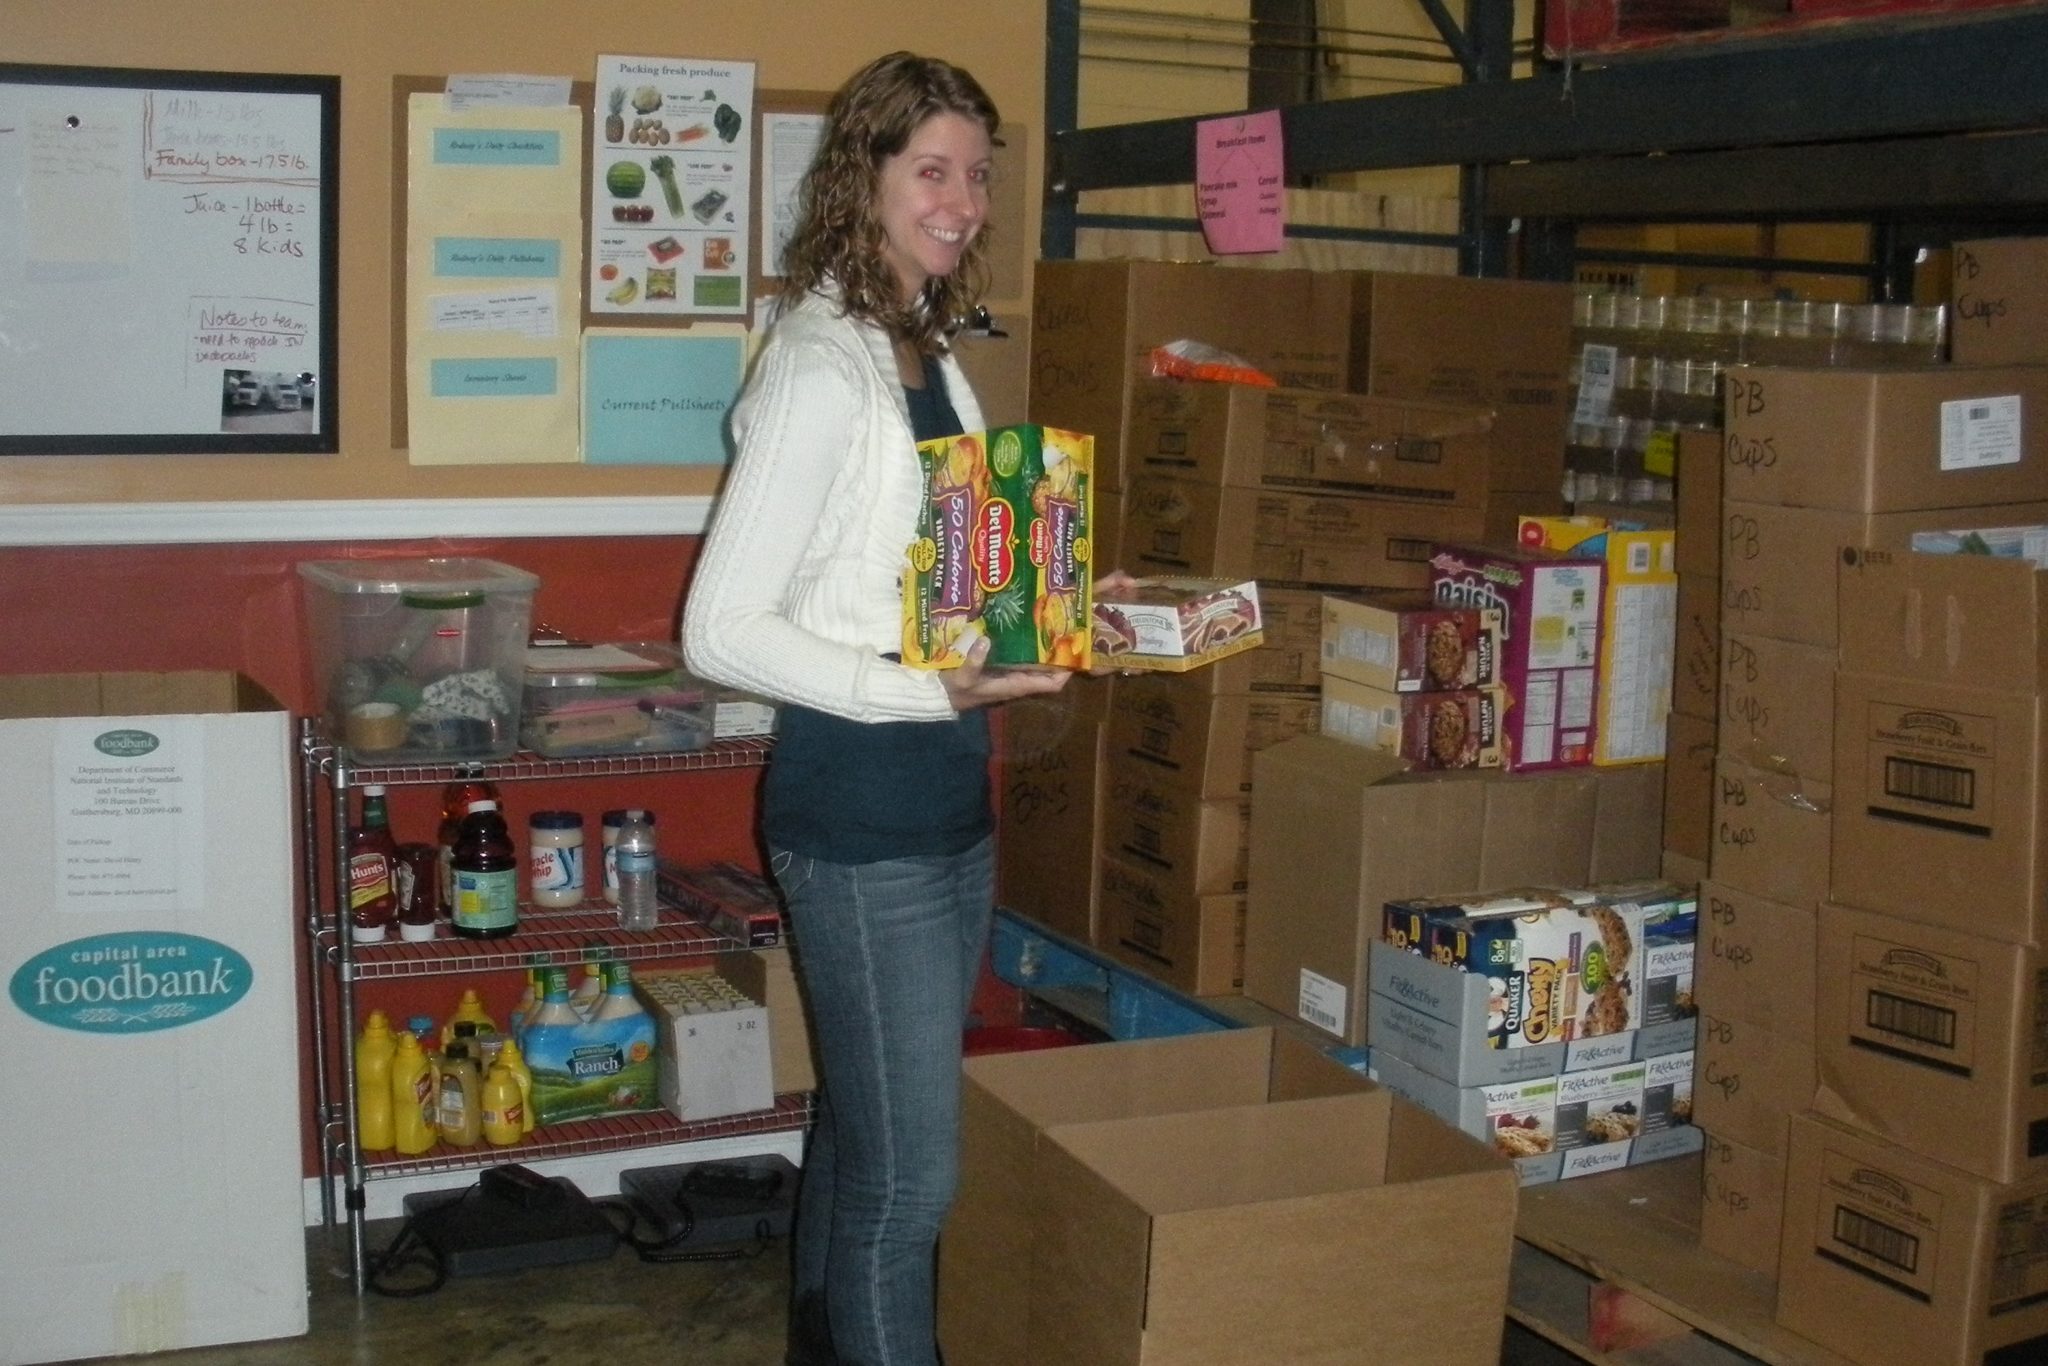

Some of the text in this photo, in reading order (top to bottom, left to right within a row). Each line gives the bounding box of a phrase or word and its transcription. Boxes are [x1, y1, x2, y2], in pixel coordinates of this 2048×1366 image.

[620, 63, 731, 78] Packing fresh produce
[155, 149, 246, 173] Family box
[183, 192, 226, 214] Juice
[239, 214, 254, 234] 4
[234, 238, 247, 254] 8
[1955, 248, 1981, 279] PB
[202, 305, 247, 327] Notes
[250, 310, 268, 327] to
[1957, 298, 2007, 328] Cups
[602, 398, 656, 411] Current
[1729, 378, 1765, 418] PB
[1727, 434, 1777, 476] Cups
[951, 496, 964, 605] 50 Calorie
[977, 529, 987, 562] Quality
[988, 504, 1002, 586] Del Monte
[1053, 506, 1064, 586] 50 Calorie
[1728, 514, 1761, 559] PB
[934, 518, 945, 588] VARIETY PACK
[1728, 639, 1759, 682] PB
[1724, 685, 1769, 737] Cups
[100, 737, 155, 749] foodbank
[78, 766, 123, 775] Department
[113, 787, 156, 796] Technology
[1720, 776, 1748, 806] PB
[125, 807, 140, 815] MD
[1710, 898, 1736, 925] PB
[72, 944, 187, 965] capital area
[1587, 951, 1598, 984] 100
[1711, 938, 1753, 970] Cups
[35, 957, 235, 1005] foodbank
[1389, 975, 1440, 1008] Fit&Active
[1505, 976, 1521, 1030] QUAKER
[1523, 957, 1556, 1043] Chewy
[1551, 969, 1562, 1029] VARIETY PACK
[1704, 1014, 1734, 1045] PB
[574, 1057, 618, 1075] Ranch
[1575, 1046, 1625, 1063] Fit&Active
[1649, 1058, 1693, 1075] Fit&Active
[1561, 1075, 1610, 1092] Fit&Active
[1705, 1061, 1740, 1100] Cups
[1486, 1089, 1518, 1103] Active
[1571, 1152, 1622, 1169] Fit&Active
[1707, 1134, 1733, 1163] PB
[1704, 1172, 1749, 1217] Cups
